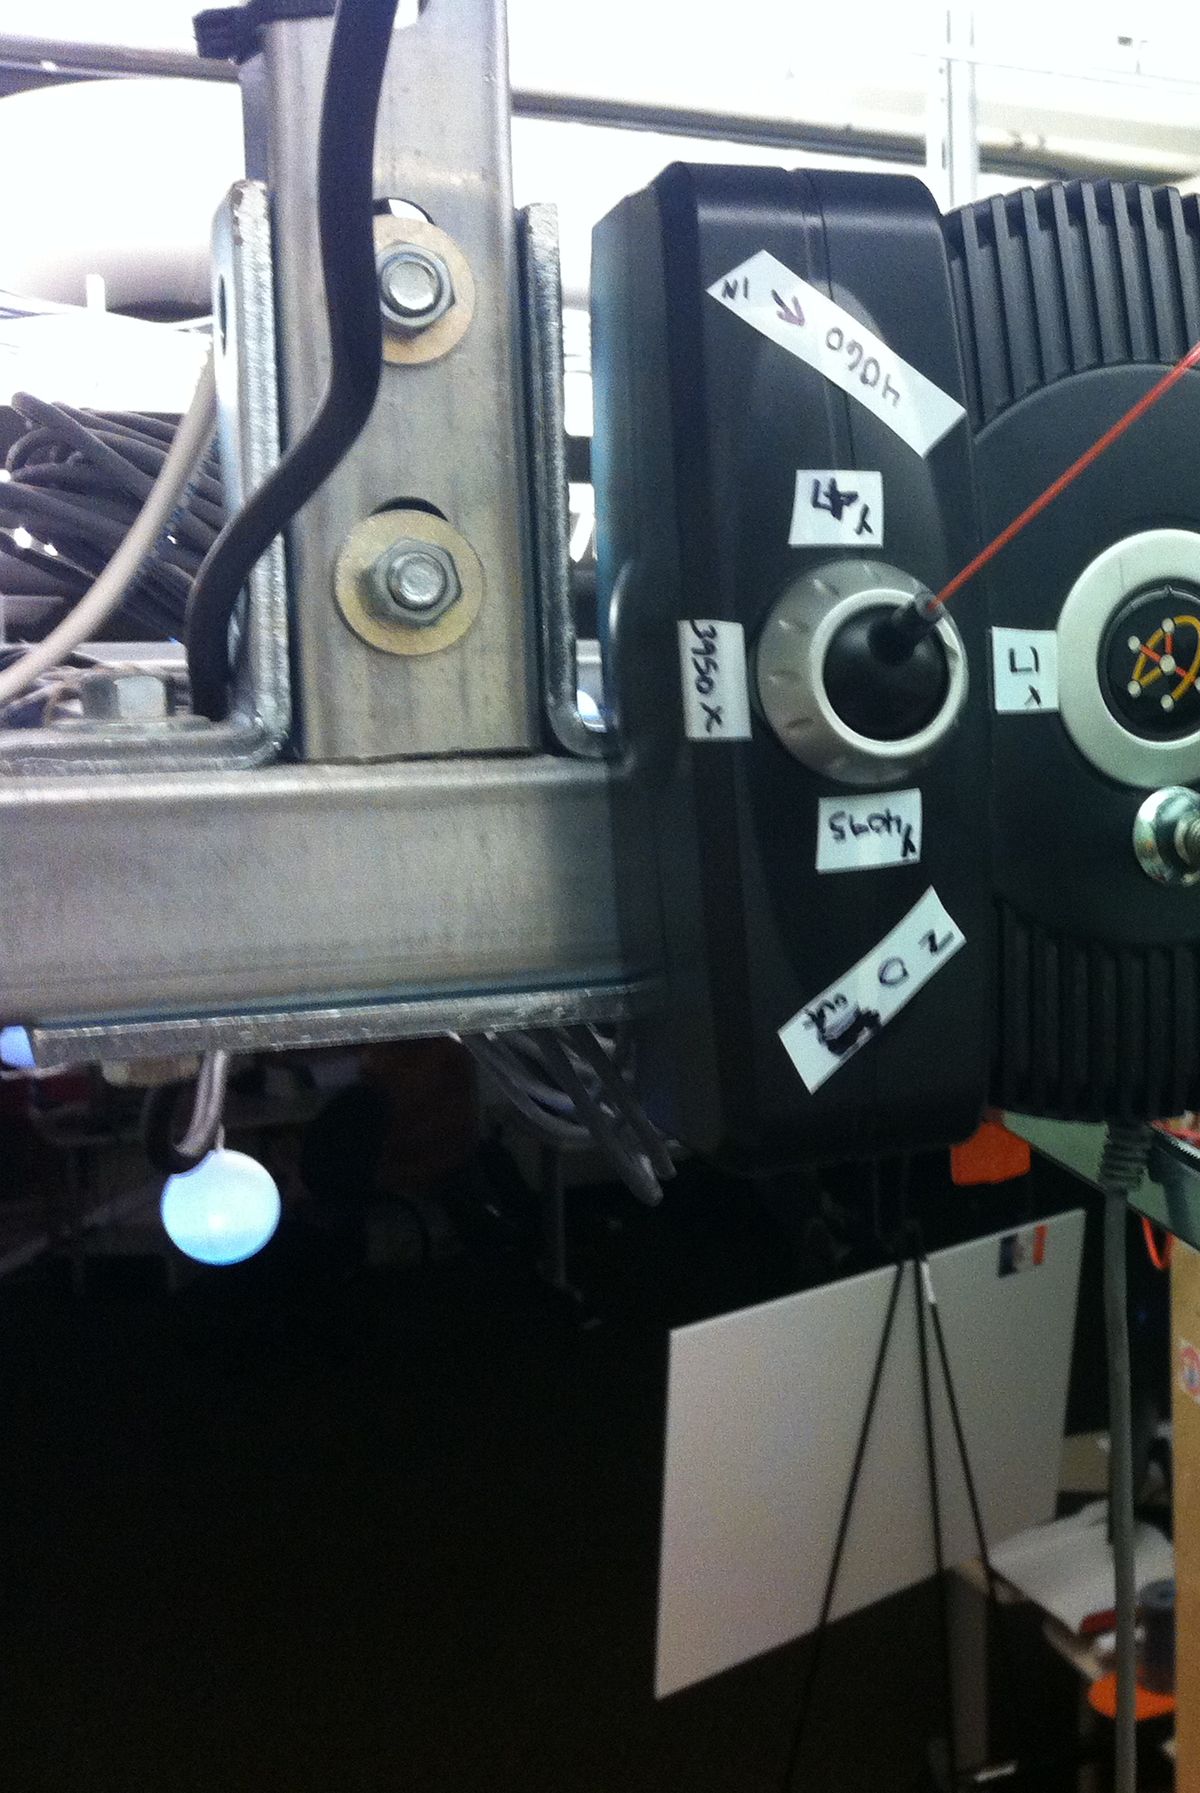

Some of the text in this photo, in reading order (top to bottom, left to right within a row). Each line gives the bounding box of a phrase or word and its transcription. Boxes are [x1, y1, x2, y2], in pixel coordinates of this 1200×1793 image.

[721, 275, 901, 407] 4060 IN
[690, 619, 722, 734] 3950 X
